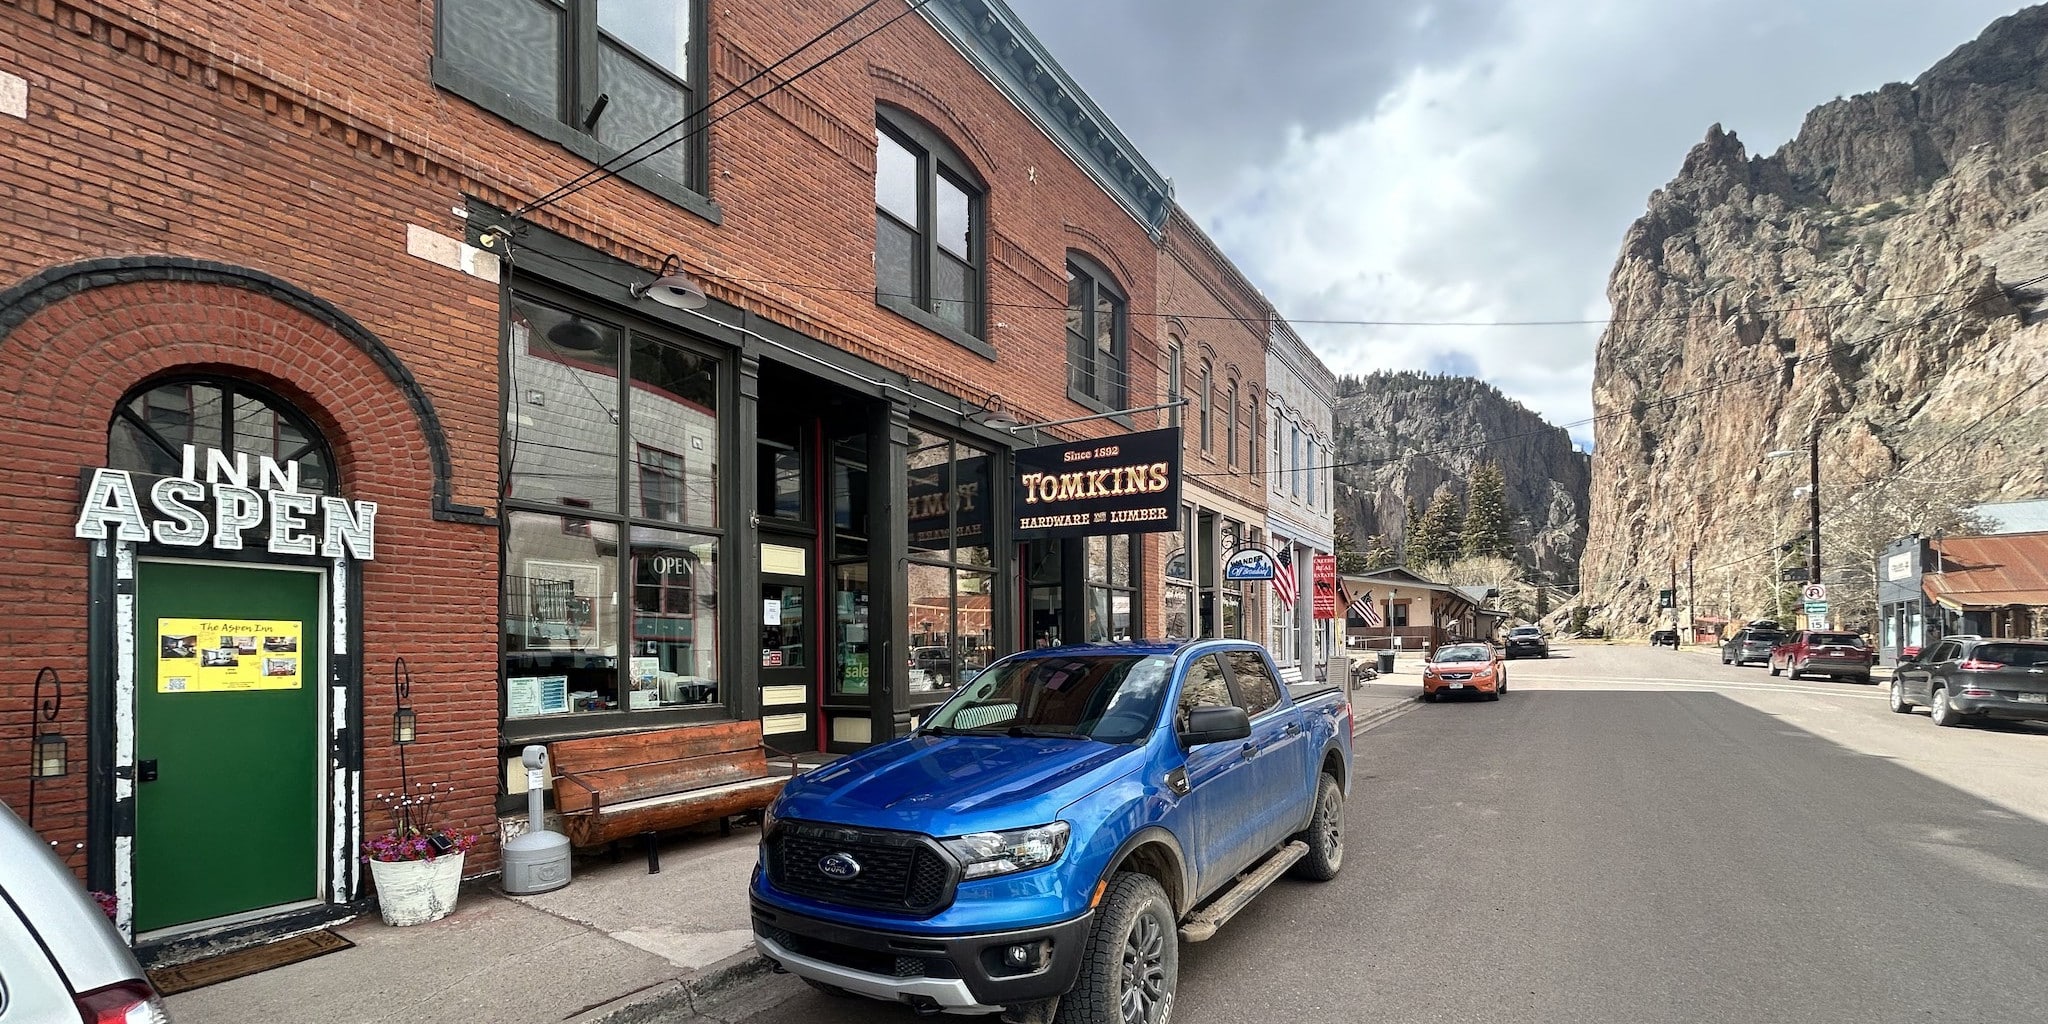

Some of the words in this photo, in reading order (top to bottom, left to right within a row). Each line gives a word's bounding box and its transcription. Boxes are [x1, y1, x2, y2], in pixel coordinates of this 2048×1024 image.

[1064, 450, 1092, 462] Since
[1093, 446, 1120, 459] 1892
[183, 444, 298, 493] INN
[1021, 461, 1169, 504] TOMKINS
[75, 467, 378, 560] ASPEN
[1020, 513, 1090, 529] HARDWARE
[1110, 507, 1168, 523] LUMBER
[653, 556, 694, 575] OPEN
[200, 622, 219, 631] The
[222, 623, 252, 633] Aspen
[255, 624, 273, 632] Inn
[1811, 621, 1823, 629] 15
[845, 662, 869, 678] sale
[825, 858, 847, 874] Ford
